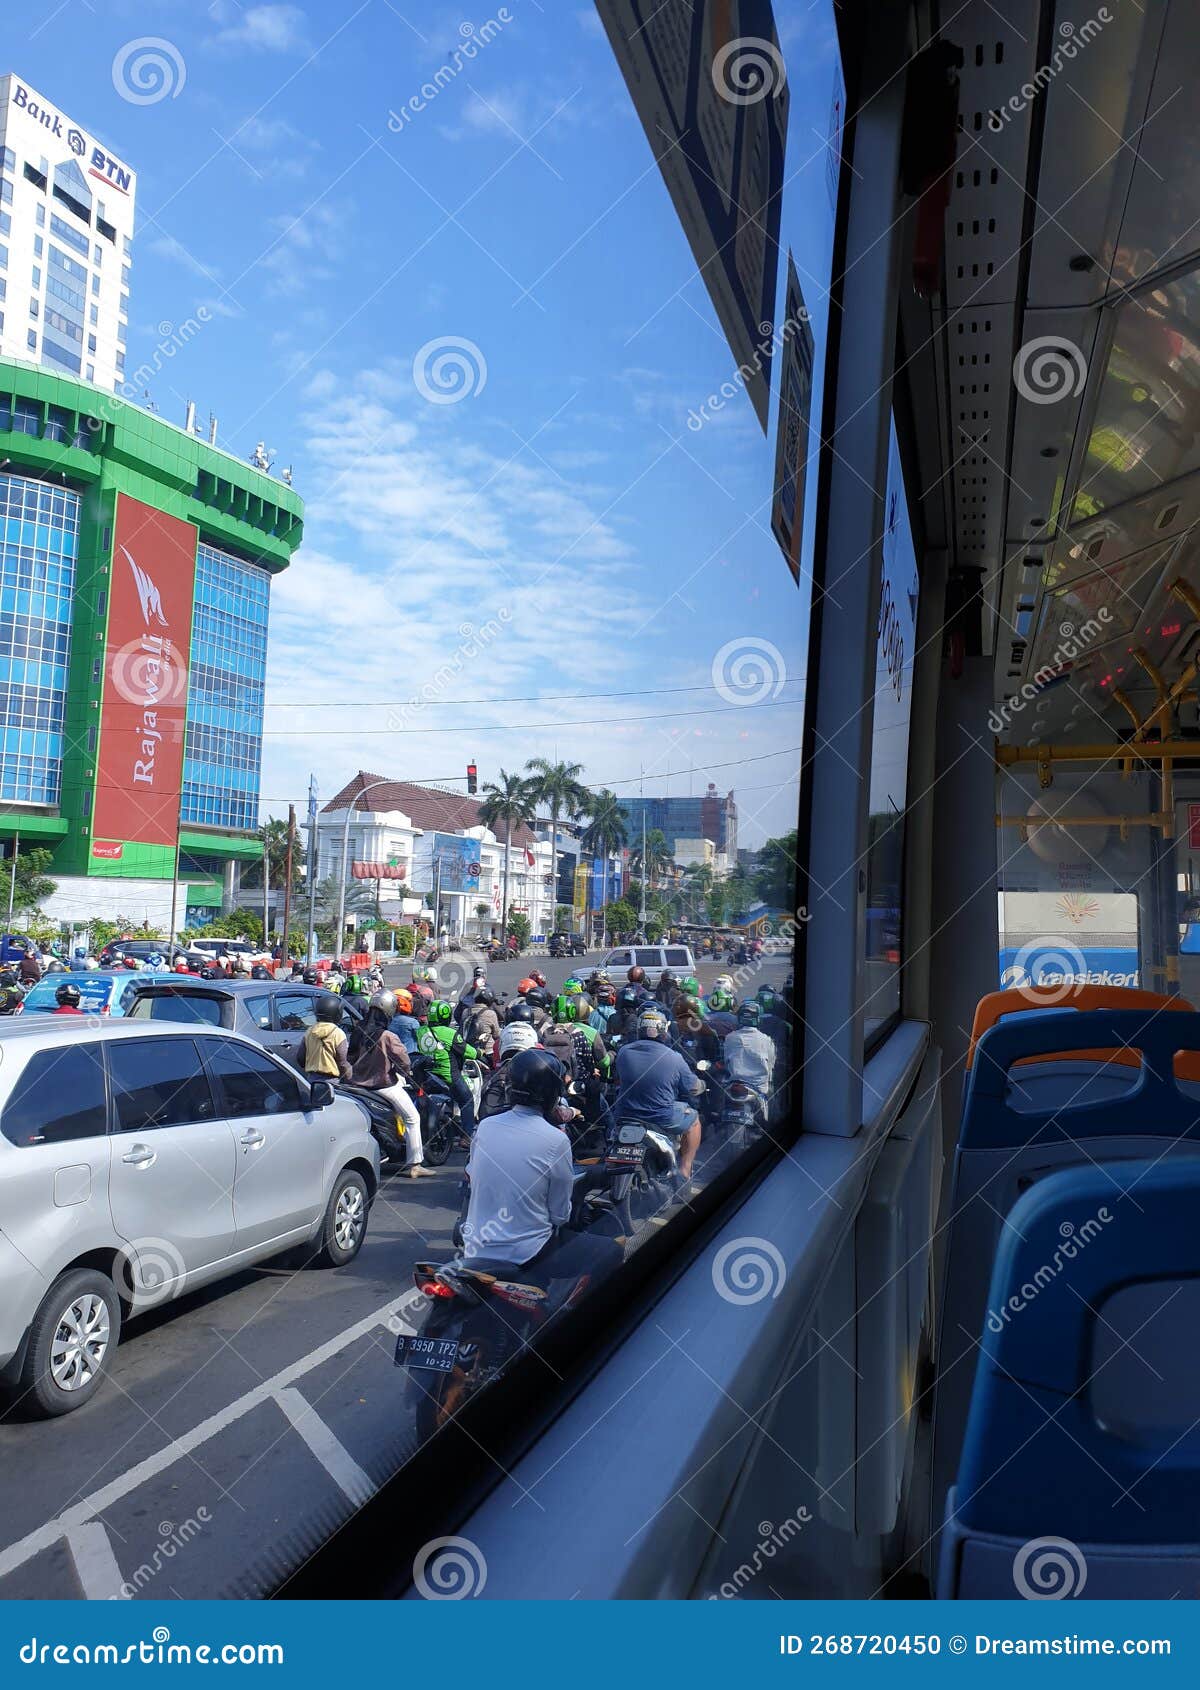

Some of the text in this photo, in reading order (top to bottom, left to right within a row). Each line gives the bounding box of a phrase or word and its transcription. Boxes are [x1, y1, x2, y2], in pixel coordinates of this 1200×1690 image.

[12, 84, 131, 191] Bank BTN
[163, 638, 173, 672] media
[133, 633, 163, 785] Rajawali
[397, 1337, 457, 1356] B 3950 TPZ
